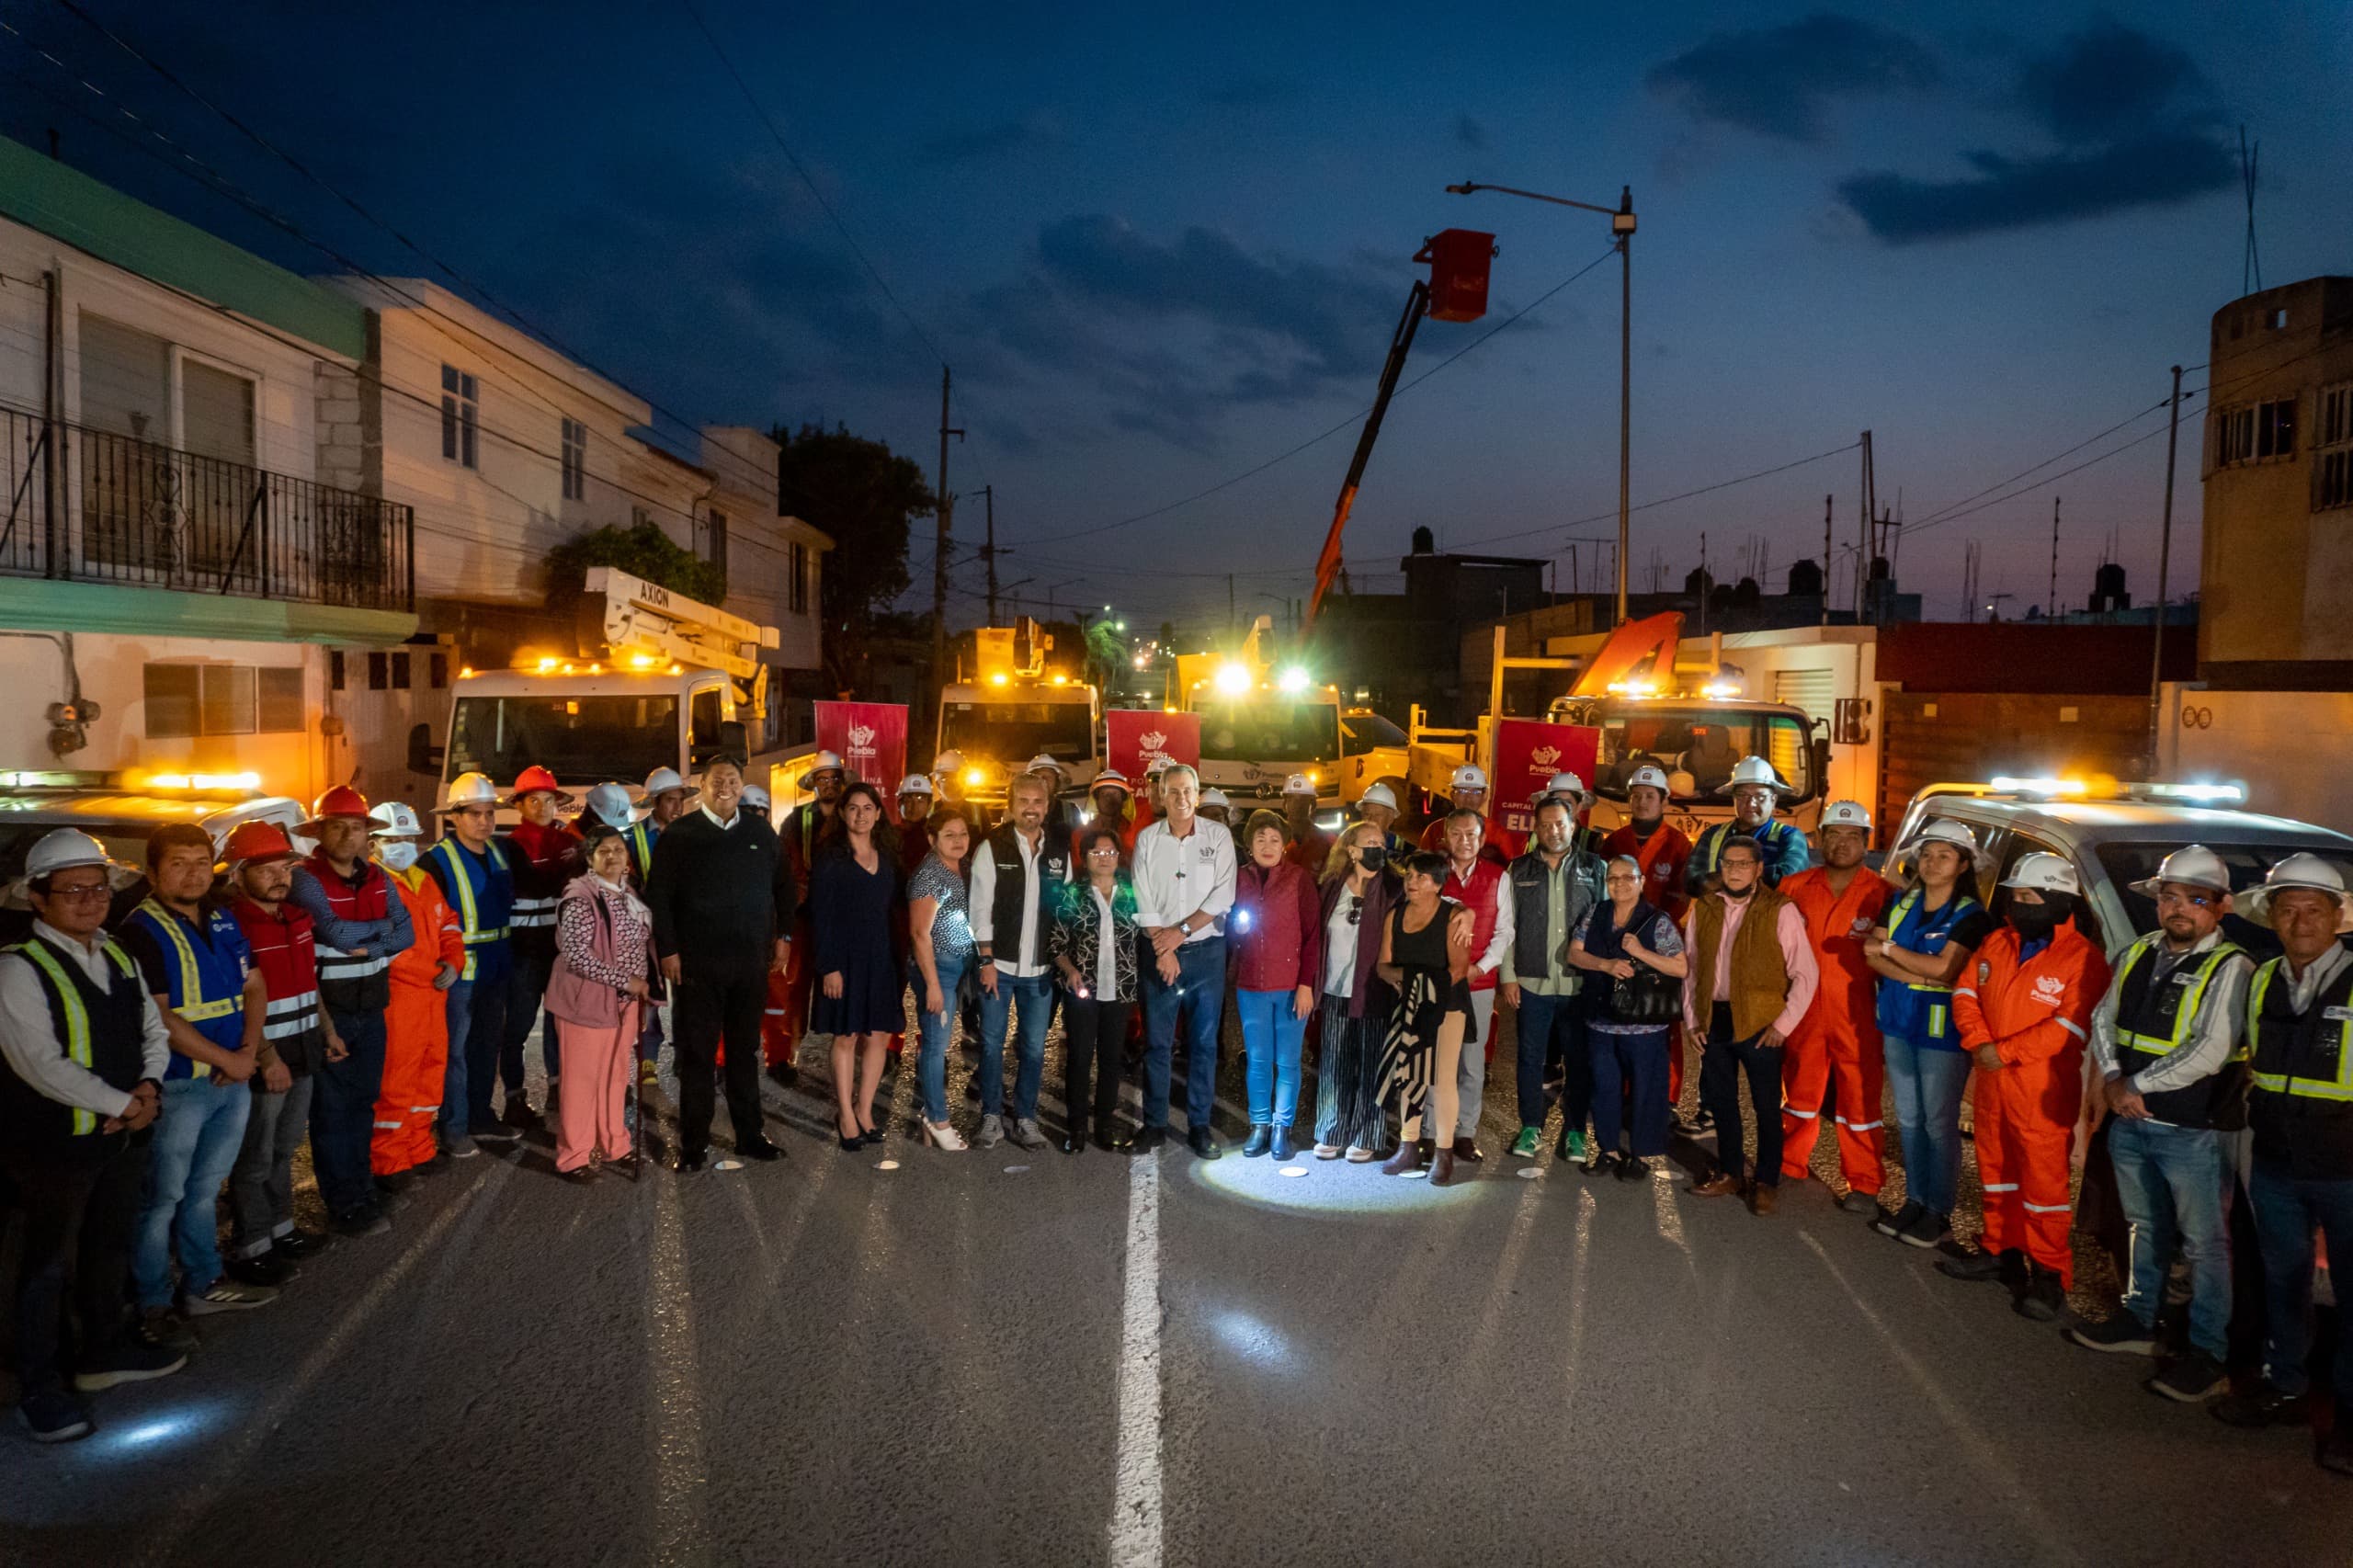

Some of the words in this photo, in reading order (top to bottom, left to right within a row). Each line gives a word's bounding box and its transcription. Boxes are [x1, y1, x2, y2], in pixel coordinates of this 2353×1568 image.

[640, 583, 669, 608] AXION
[1529, 764, 1562, 775] Puebla
[1501, 801, 1532, 811] CAPITAL
